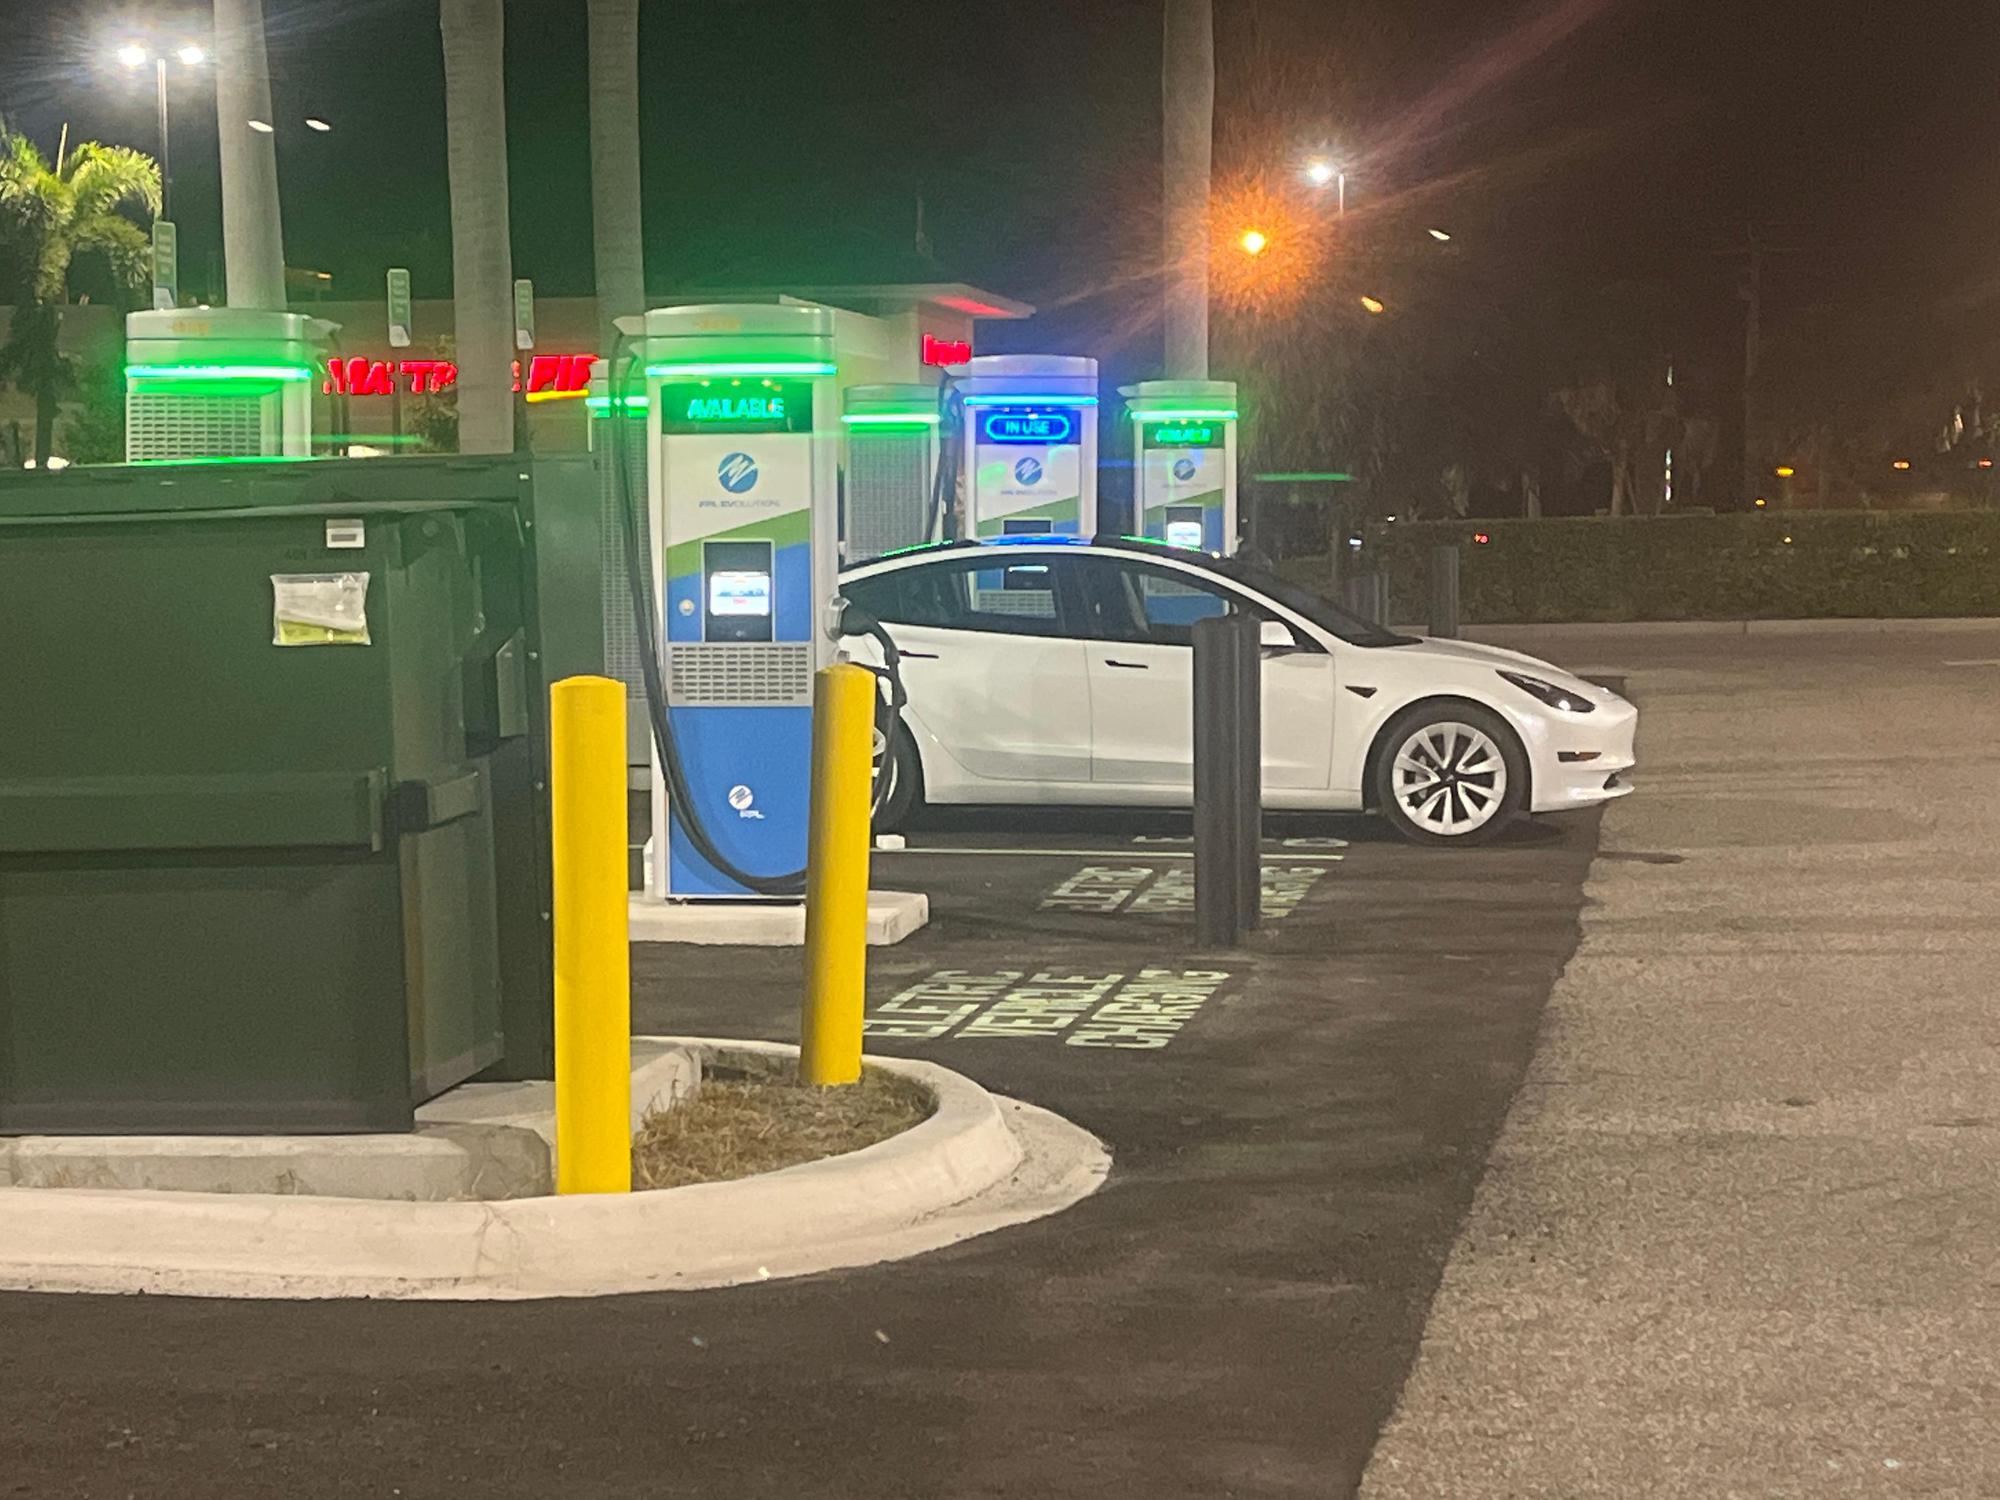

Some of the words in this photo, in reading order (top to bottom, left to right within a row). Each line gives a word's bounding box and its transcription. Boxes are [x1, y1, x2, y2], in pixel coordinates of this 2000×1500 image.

[687, 397, 784, 419] AVAILABLE
[1005, 420, 1019, 434] IN
[1023, 420, 1050, 434] USE
[953, 972, 1126, 1039] VEHICLE
[1065, 968, 1233, 1050] CHARGING
